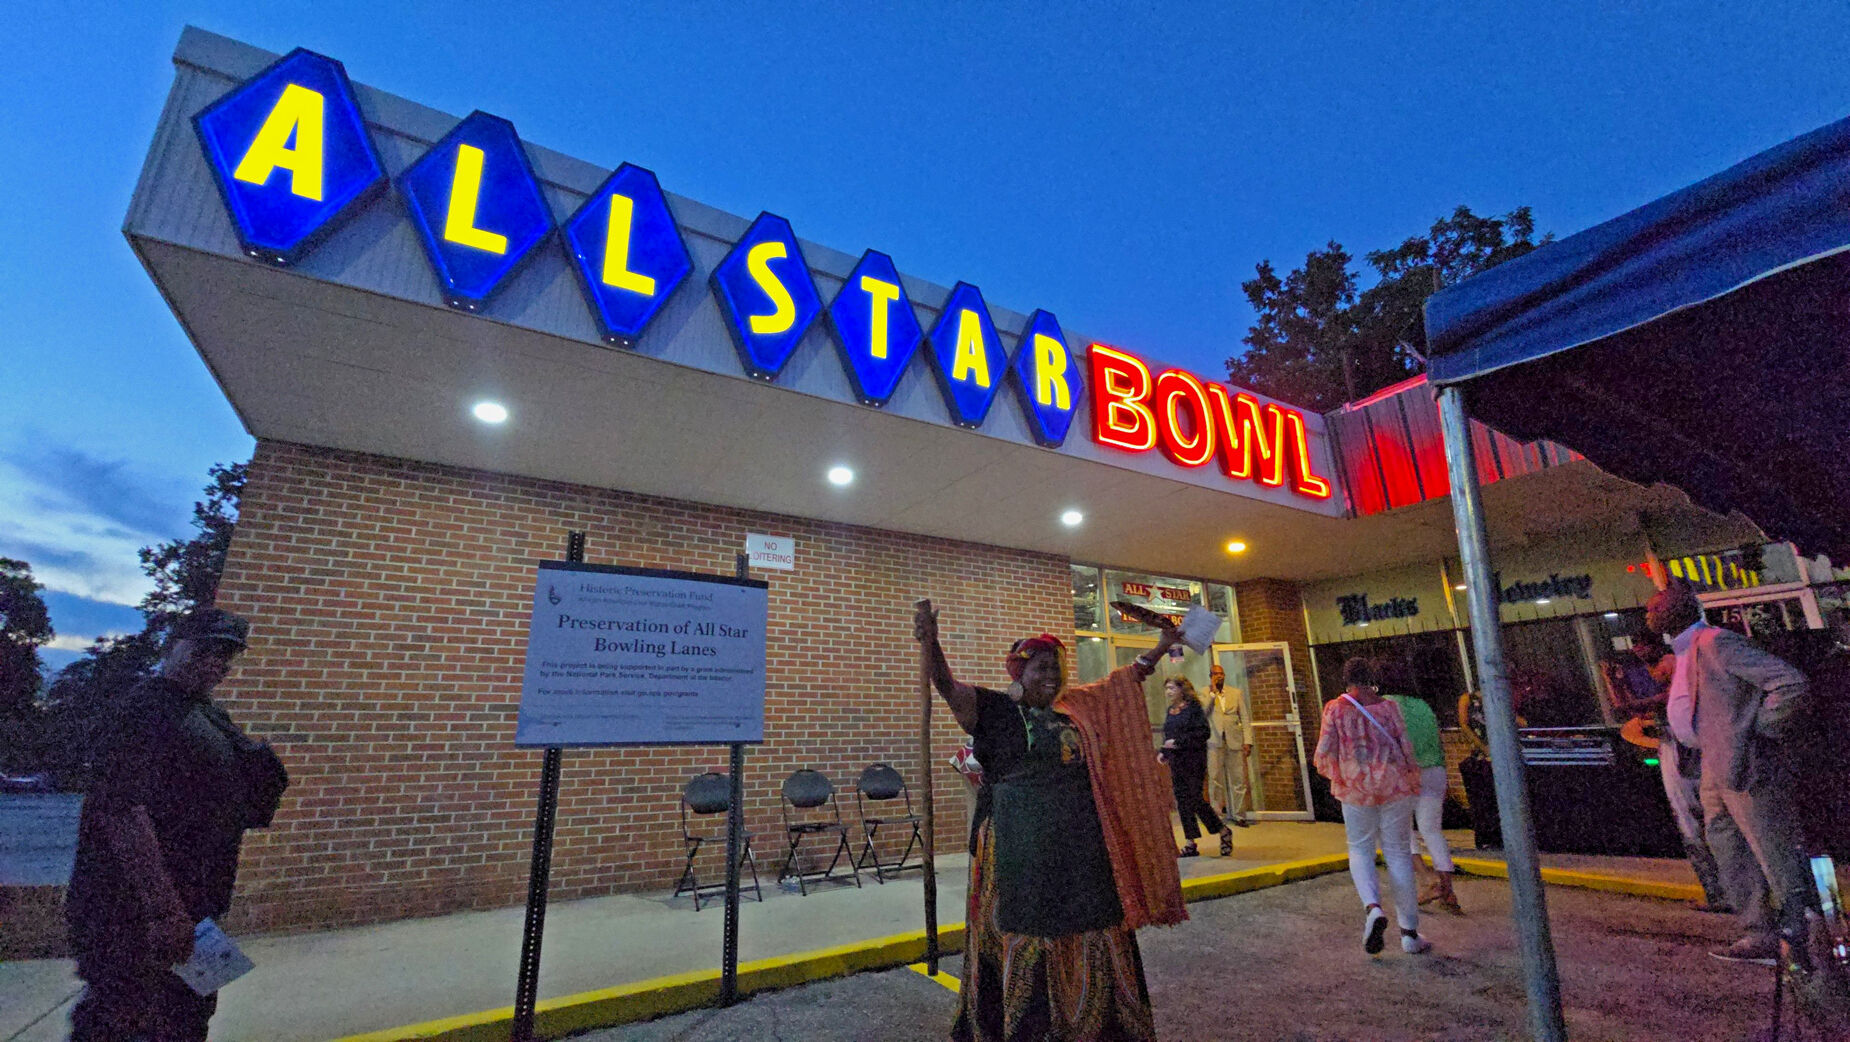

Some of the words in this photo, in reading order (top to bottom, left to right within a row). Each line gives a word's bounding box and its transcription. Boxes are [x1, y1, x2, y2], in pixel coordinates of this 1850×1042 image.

[233, 83, 655, 296] ALL
[747, 241, 1070, 410] STAR
[1090, 342, 1332, 500] BOWL
[764, 541, 778, 551] NO
[750, 551, 792, 564] OITERING
[580, 583, 620, 594] Historic
[624, 586, 687, 600] Preservation
[689, 591, 713, 602] Fund
[1125, 583, 1147, 595] ALL
[1165, 589, 1190, 600] STAR
[558, 614, 669, 634] Preservation
[673, 620, 691, 635] of
[694, 622, 715, 637] All
[719, 623, 749, 639] Star
[594, 637, 666, 658] Bowling
[670, 640, 717, 656] Lanes
